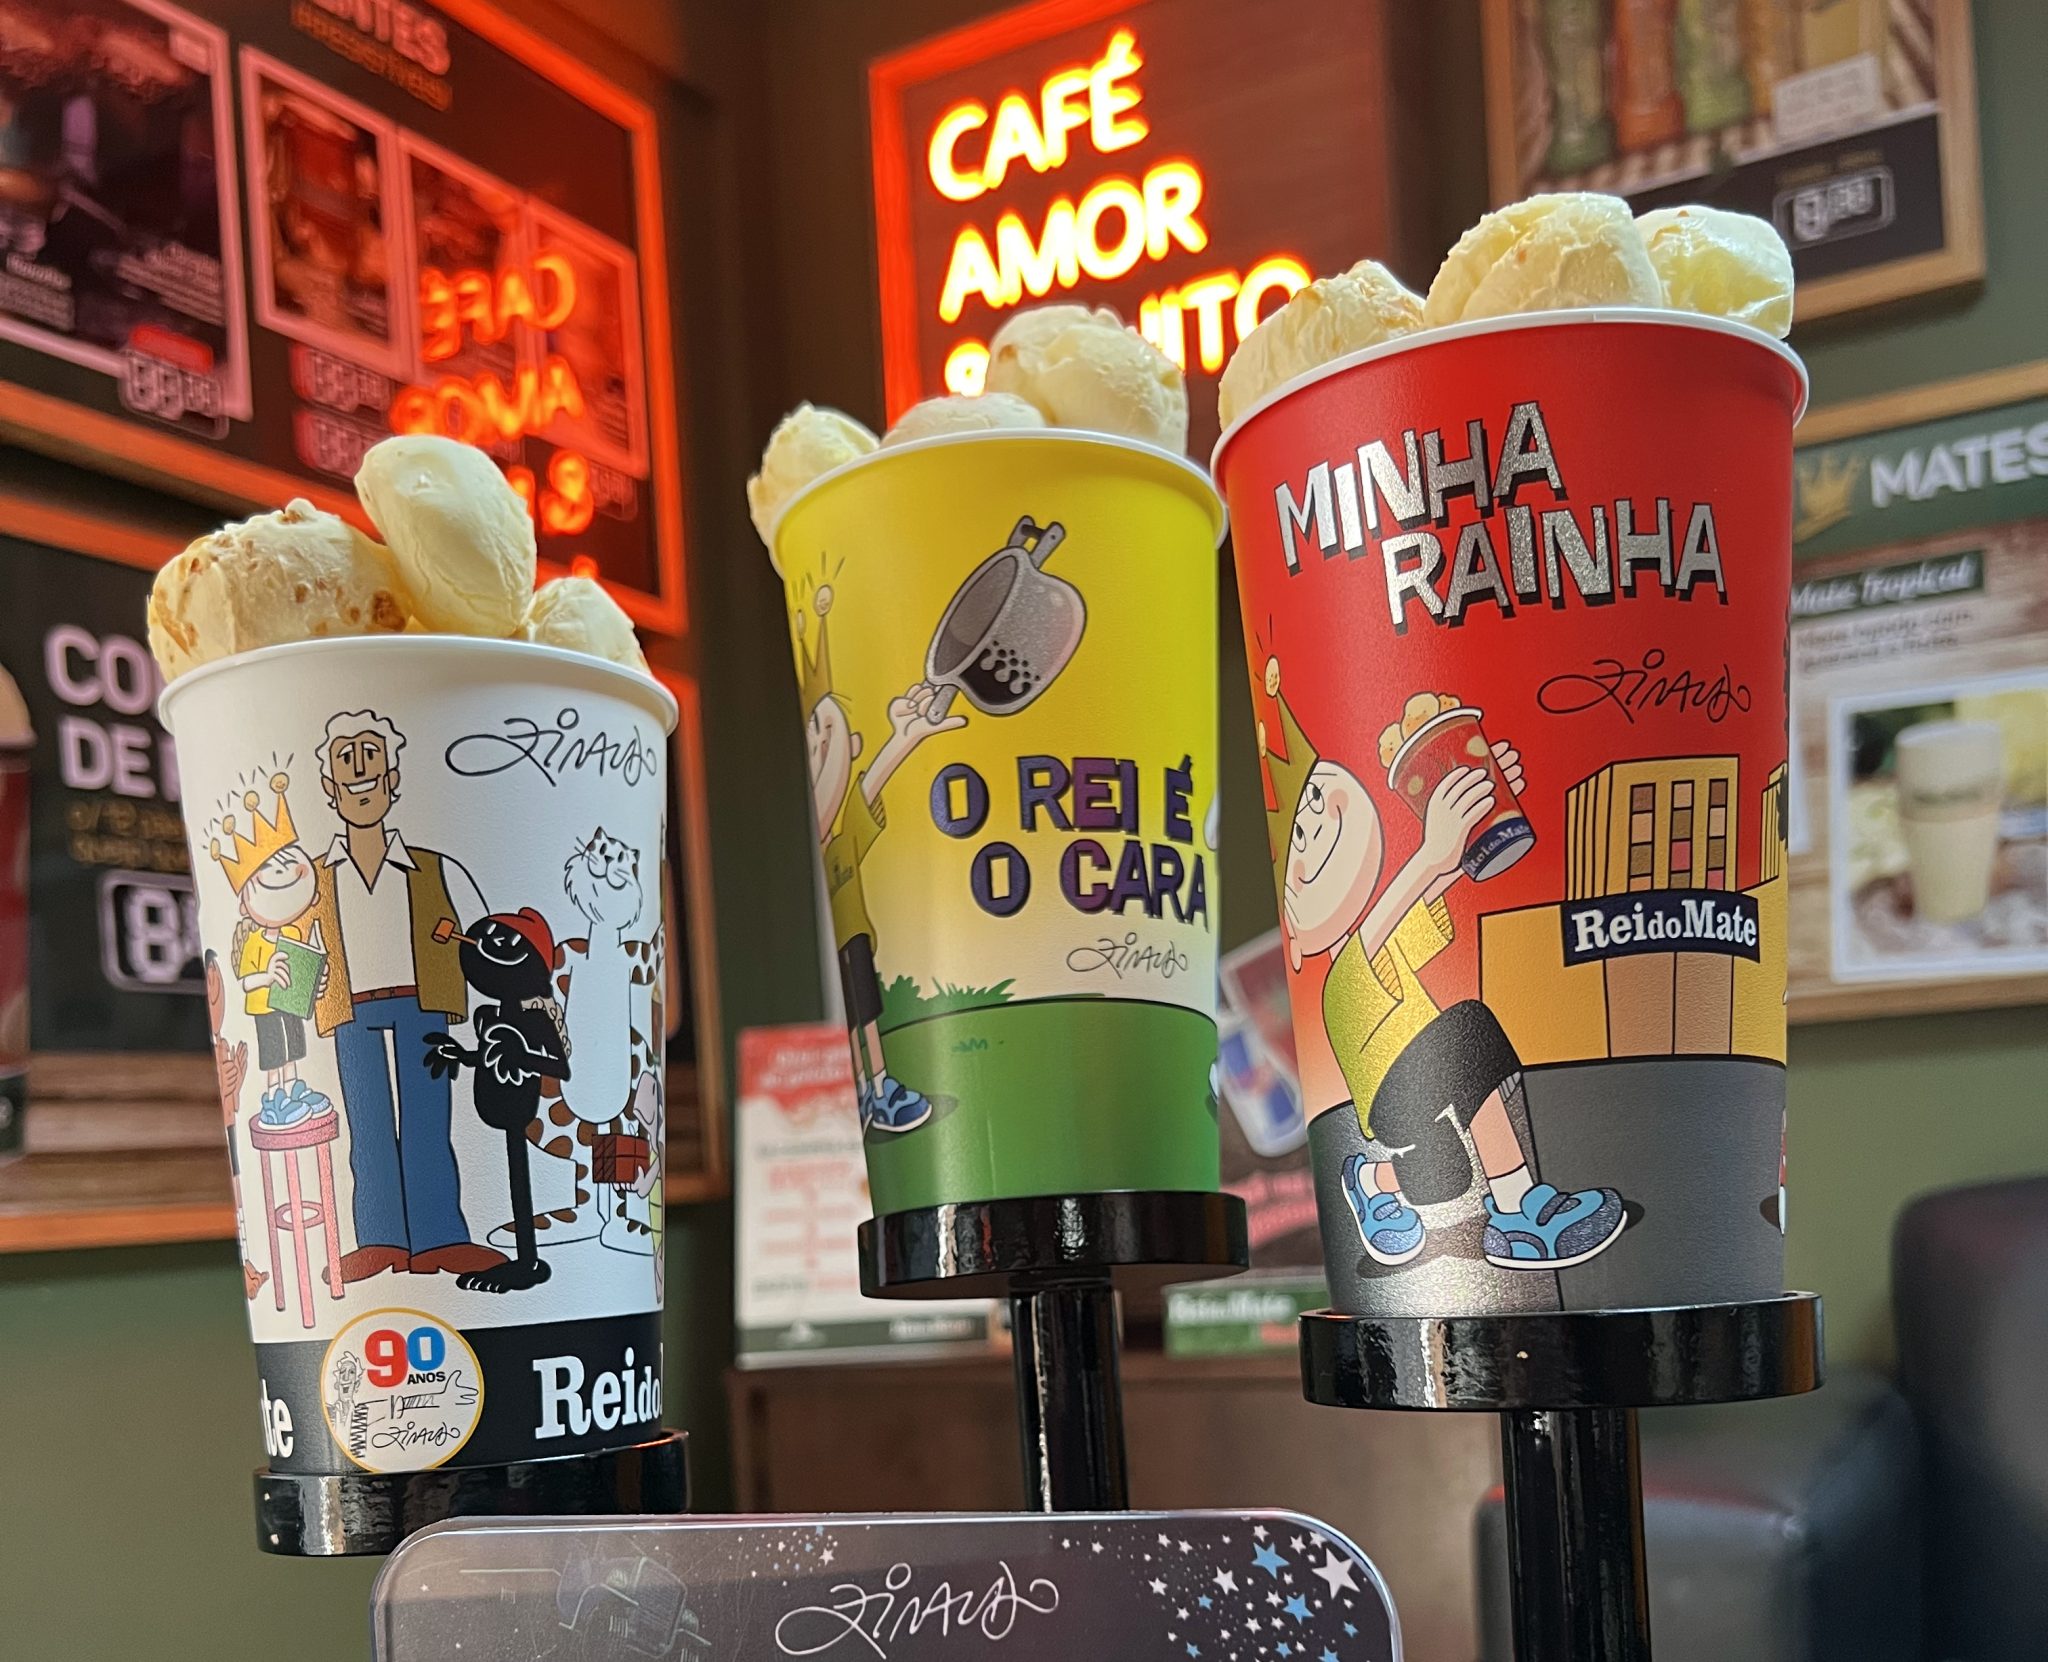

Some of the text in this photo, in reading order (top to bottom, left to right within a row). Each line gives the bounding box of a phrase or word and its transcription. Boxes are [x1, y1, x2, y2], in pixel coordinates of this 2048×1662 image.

[928, 28, 1149, 201] CAFÉ
[939, 161, 1207, 322] AMOR
[1274, 400, 1569, 575] MINHA
[1870, 423, 2048, 508] MATES
[1380, 496, 1729, 636] RAINHA
[58, 714, 156, 799] DE
[930, 754, 1194, 844] O REI É
[970, 838, 1210, 933] O CARA
[364, 1326, 446, 1388] 90
[407, 1371, 446, 1385] ANOS
